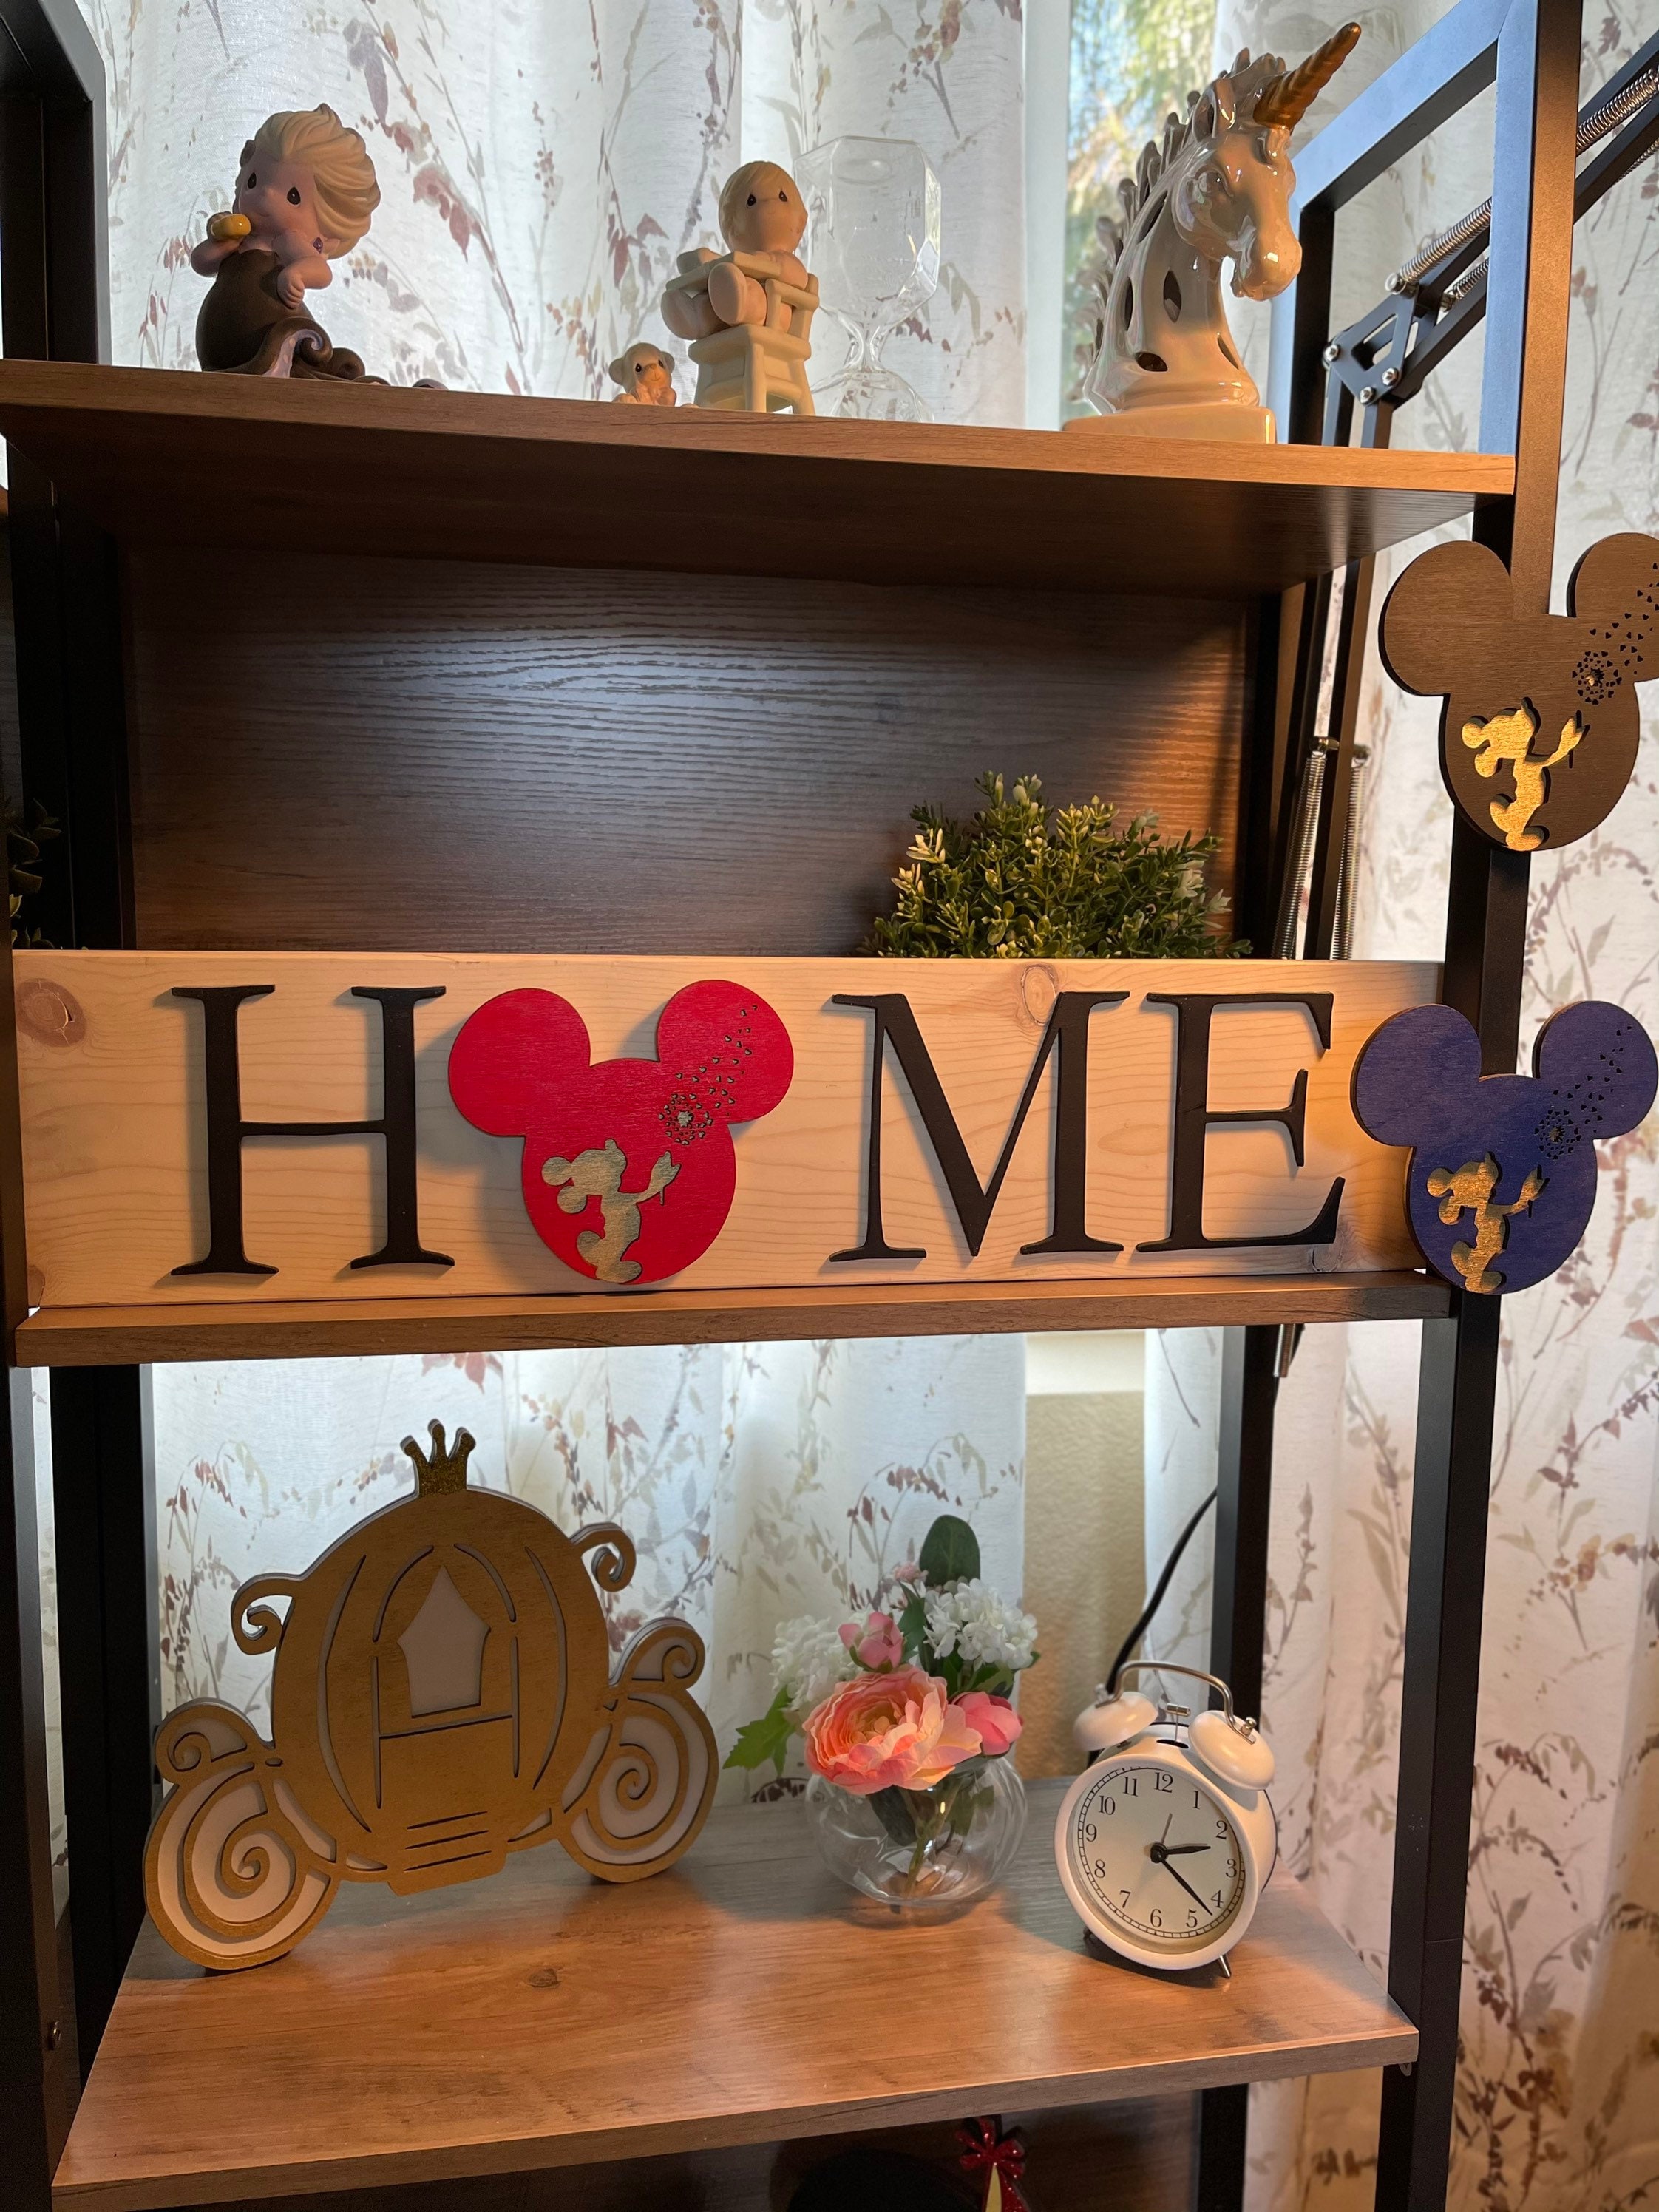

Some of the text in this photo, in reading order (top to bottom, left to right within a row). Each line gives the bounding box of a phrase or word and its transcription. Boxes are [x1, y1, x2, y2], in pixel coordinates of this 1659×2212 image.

[1123, 1776, 1139, 1797] 11
[1154, 1772, 1173, 1794] 12
[1099, 1795, 1116, 1815] 10
[1192, 1790, 1201, 1809] 1
[1085, 1823, 1097, 1842] 9
[1215, 1819, 1228, 1840] 2
[1094, 1859, 1106, 1879] 8
[1225, 1858, 1237, 1878] 3
[1119, 1890, 1131, 1908] 7
[1210, 1890, 1224, 1908] 4
[1150, 1908, 1162, 1928] 6
[1186, 1908, 1198, 1928] 5
